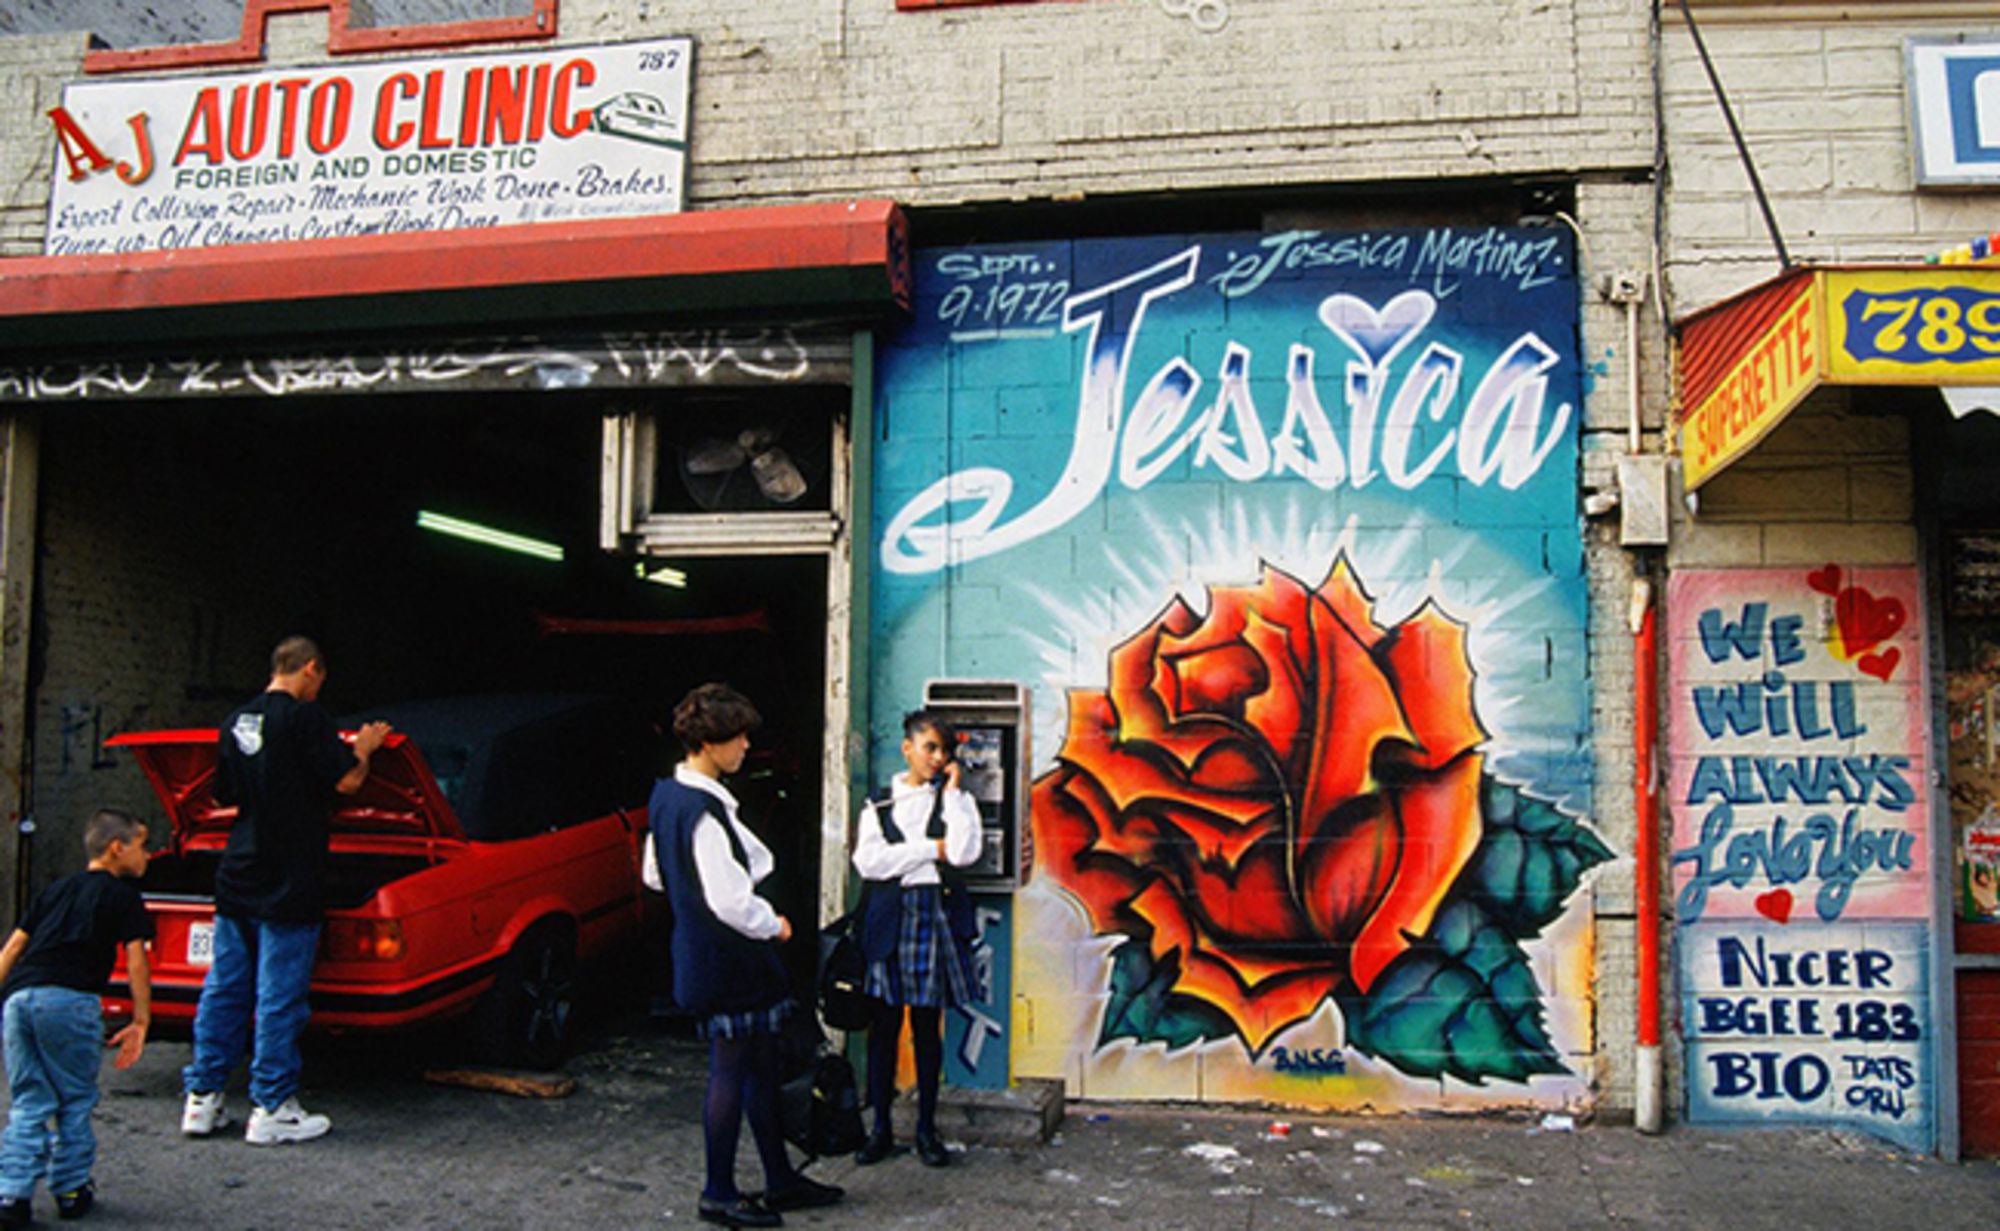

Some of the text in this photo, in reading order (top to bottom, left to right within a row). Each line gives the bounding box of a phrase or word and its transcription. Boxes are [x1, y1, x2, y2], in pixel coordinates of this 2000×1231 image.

[637, 49, 680, 71] 787
[172, 57, 596, 167] AUTO CLINIC
[56, 200, 122, 231] Expert
[131, 194, 219, 223] Collision
[309, 182, 418, 212] Mechanic
[427, 176, 486, 206] Work
[495, 173, 560, 202] Done
[576, 162, 673, 198] Brakes.
[174, 147, 537, 190] FOREIGN AND DOMESTIC
[1207, 228, 1409, 298] Jessica
[1861, 297, 2000, 354] 789
[881, 246, 1572, 574] Jessica
[1696, 296, 1814, 466] SUPERETTE
[1698, 602, 1806, 667] WE
[1832, 1000, 1921, 1041] 183
[1707, 1051, 1915, 1103] BIO TATS
